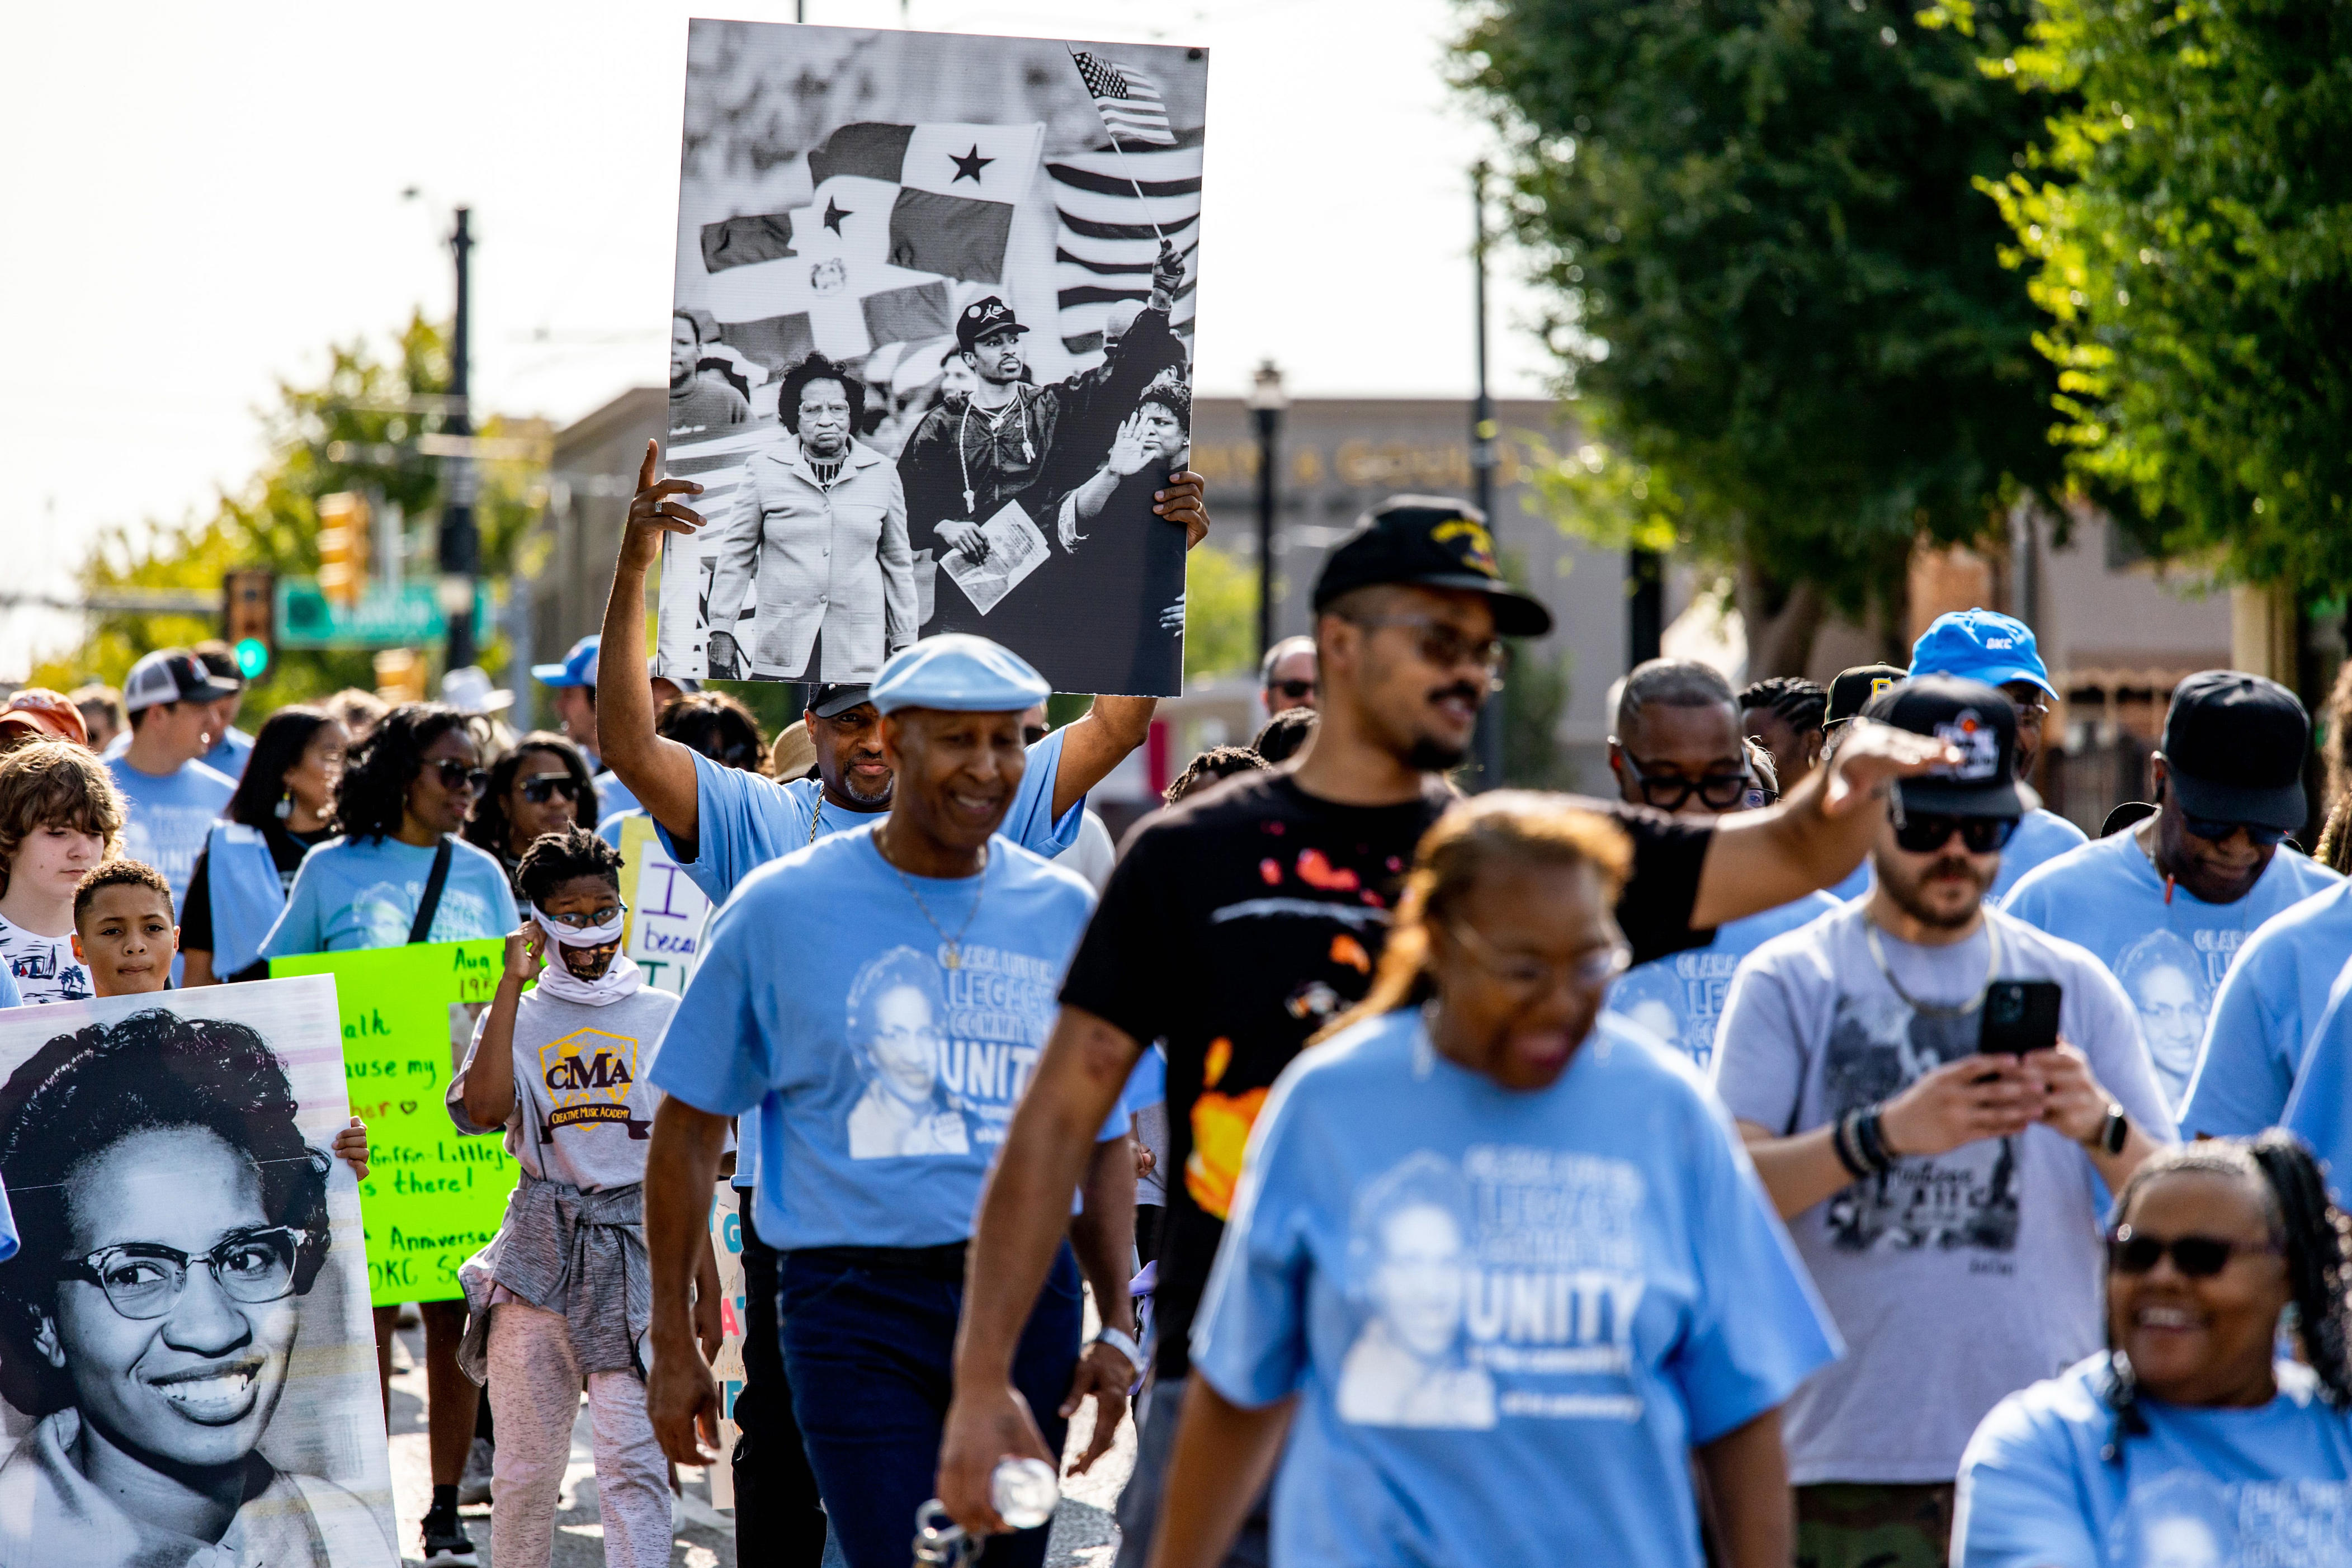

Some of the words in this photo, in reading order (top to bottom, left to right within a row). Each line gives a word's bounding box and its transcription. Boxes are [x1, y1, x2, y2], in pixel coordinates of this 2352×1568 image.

[1986, 637, 2013, 650] OKC
[1869, 677, 1896, 707] P
[453, 947, 490, 979] Aug
[407, 1060, 436, 1090] my
[546, 1053, 633, 1090] CMA
[552, 1109, 580, 1125] CREATIVE
[580, 1107, 599, 1118] MUSIC
[599, 1107, 630, 1118] ACADEMY
[393, 1166, 473, 1198] there!
[1464, 1268, 1645, 1348] UNITY
